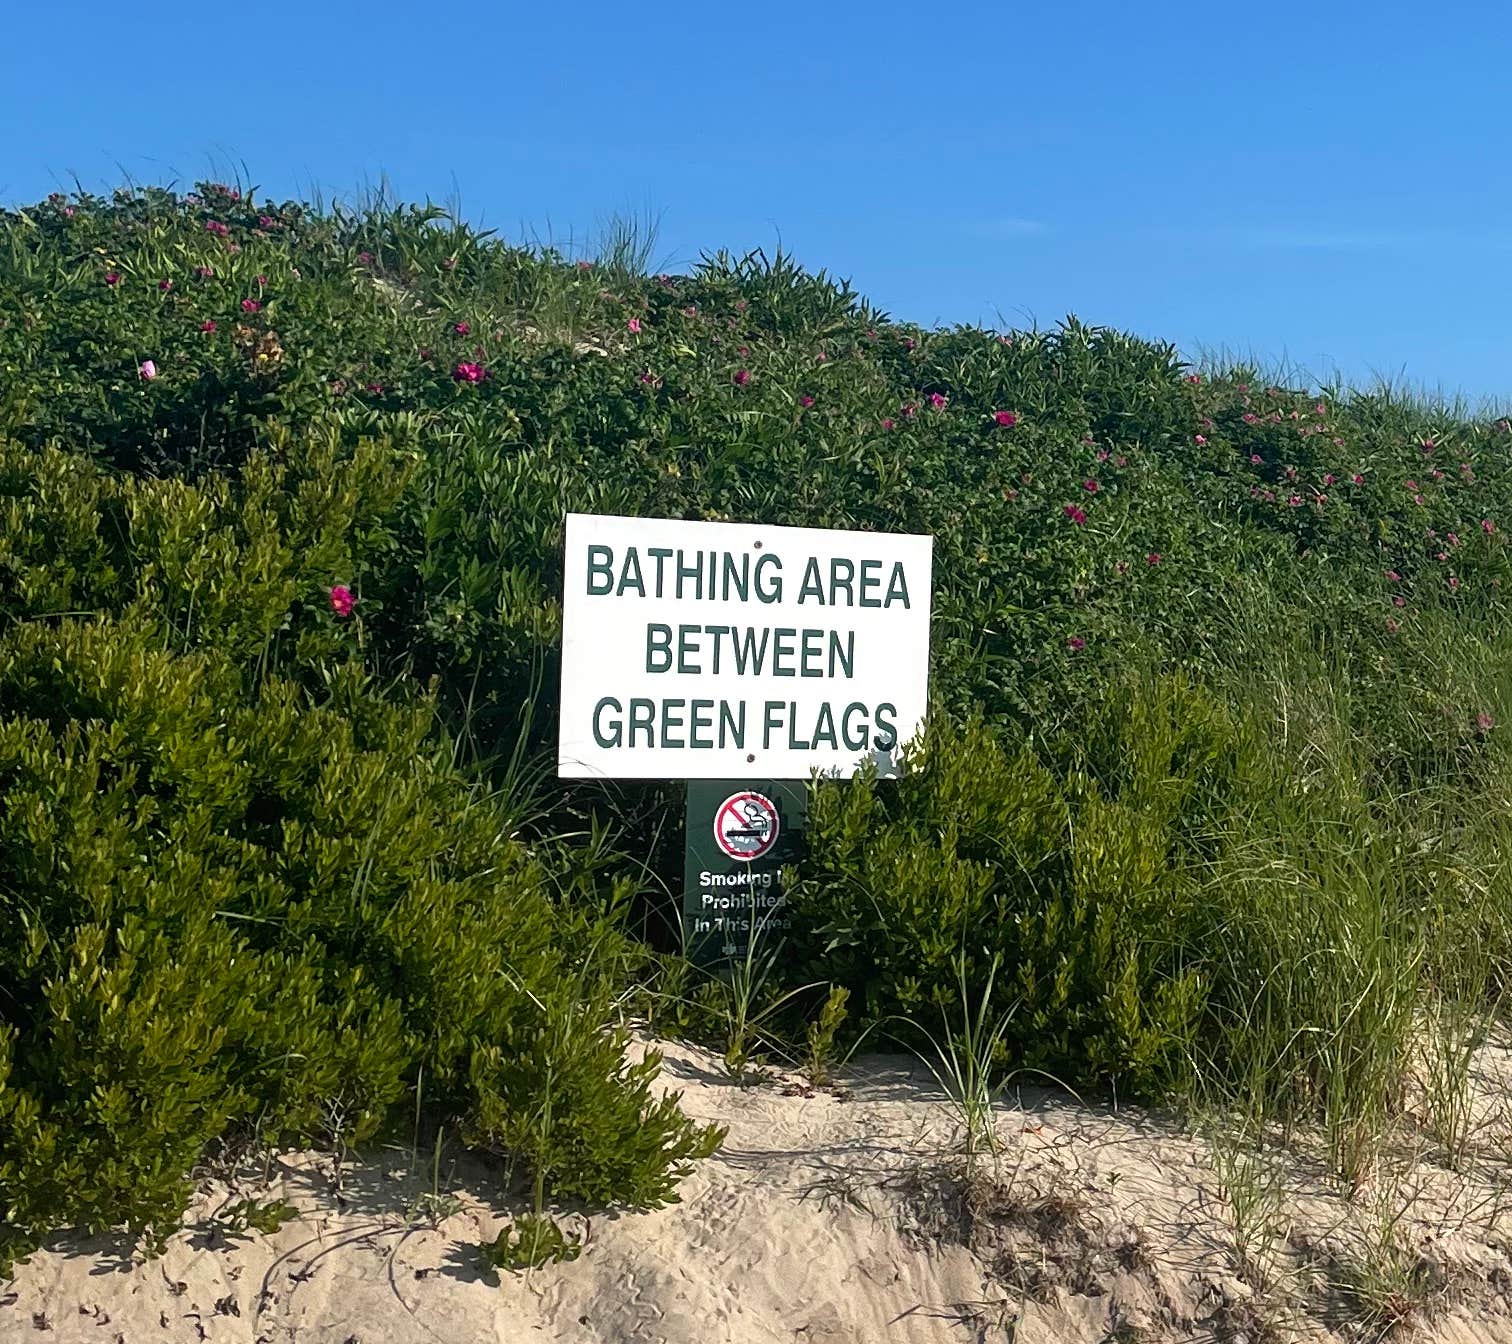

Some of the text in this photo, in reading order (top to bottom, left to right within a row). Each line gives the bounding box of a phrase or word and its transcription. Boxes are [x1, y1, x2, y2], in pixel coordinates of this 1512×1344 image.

[586, 544, 911, 610] BATHING AREA
[645, 622, 855, 678] BETWEEN
[592, 696, 898, 752] GREEN FLAGS
[699, 870, 772, 888] Smoking
[694, 917, 710, 933] In
